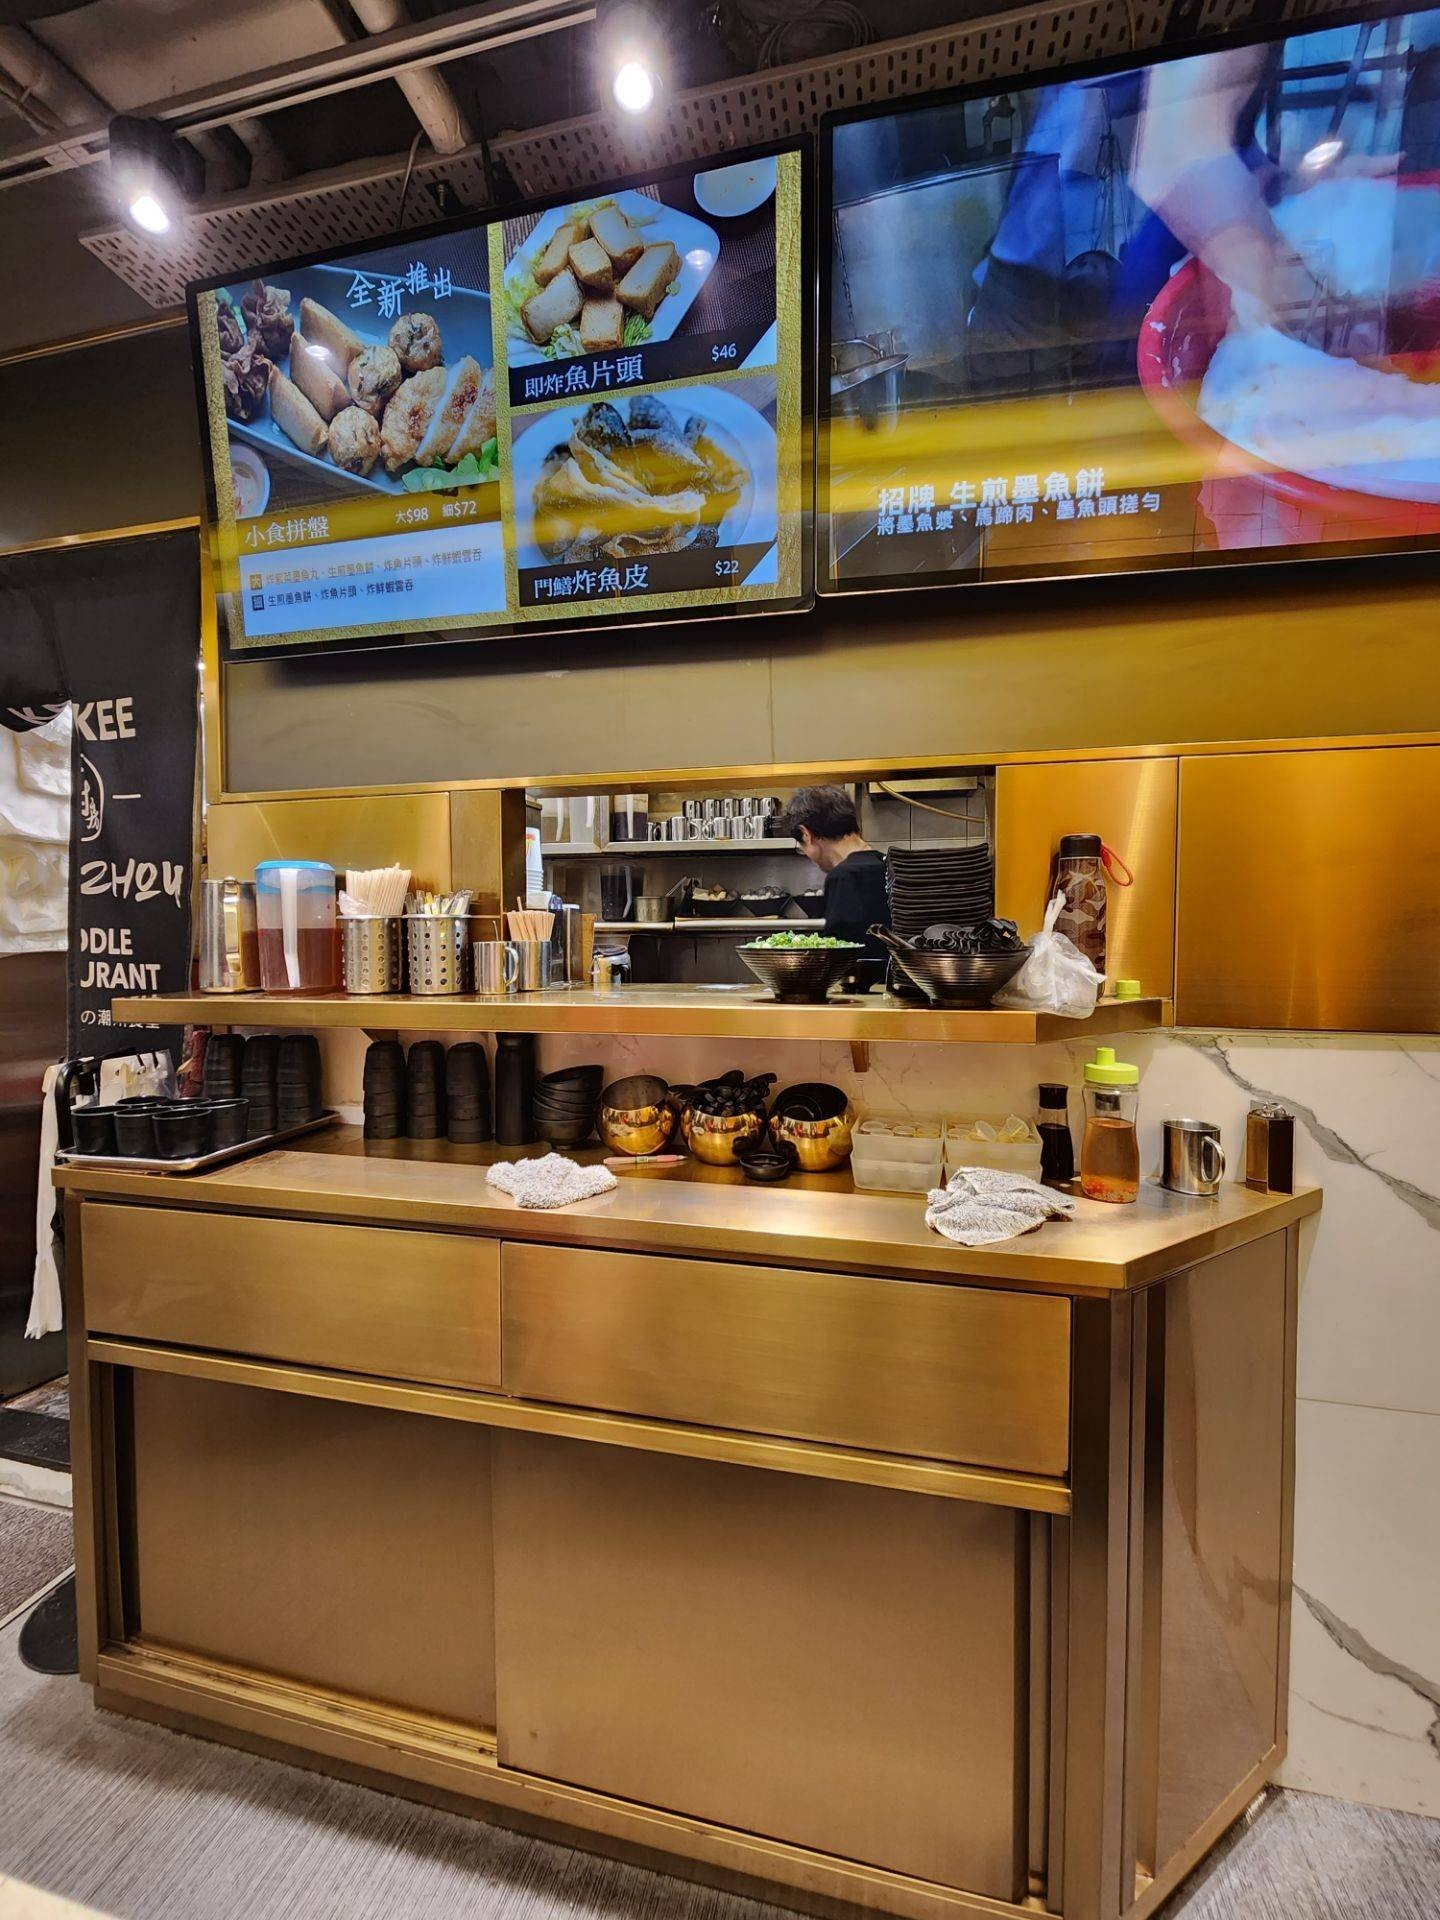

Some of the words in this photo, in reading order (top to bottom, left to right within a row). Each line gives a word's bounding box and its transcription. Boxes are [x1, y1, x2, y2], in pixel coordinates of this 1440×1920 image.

[346, 261, 452, 319] 全新推出
[711, 343, 737, 361] $46
[525, 354, 644, 398] 即炸魚片頭
[878, 486, 936, 517] 招牌
[950, 467, 1105, 510] 生煎墨魚餅
[245, 516, 330, 548] 小食拼盤
[395, 508, 429, 524] 大$98
[534, 564, 649, 599] 門鱔炸魚皮
[714, 560, 739, 576] $22
[73, 697, 137, 741] KEE
[80, 927, 134, 956] DLE
